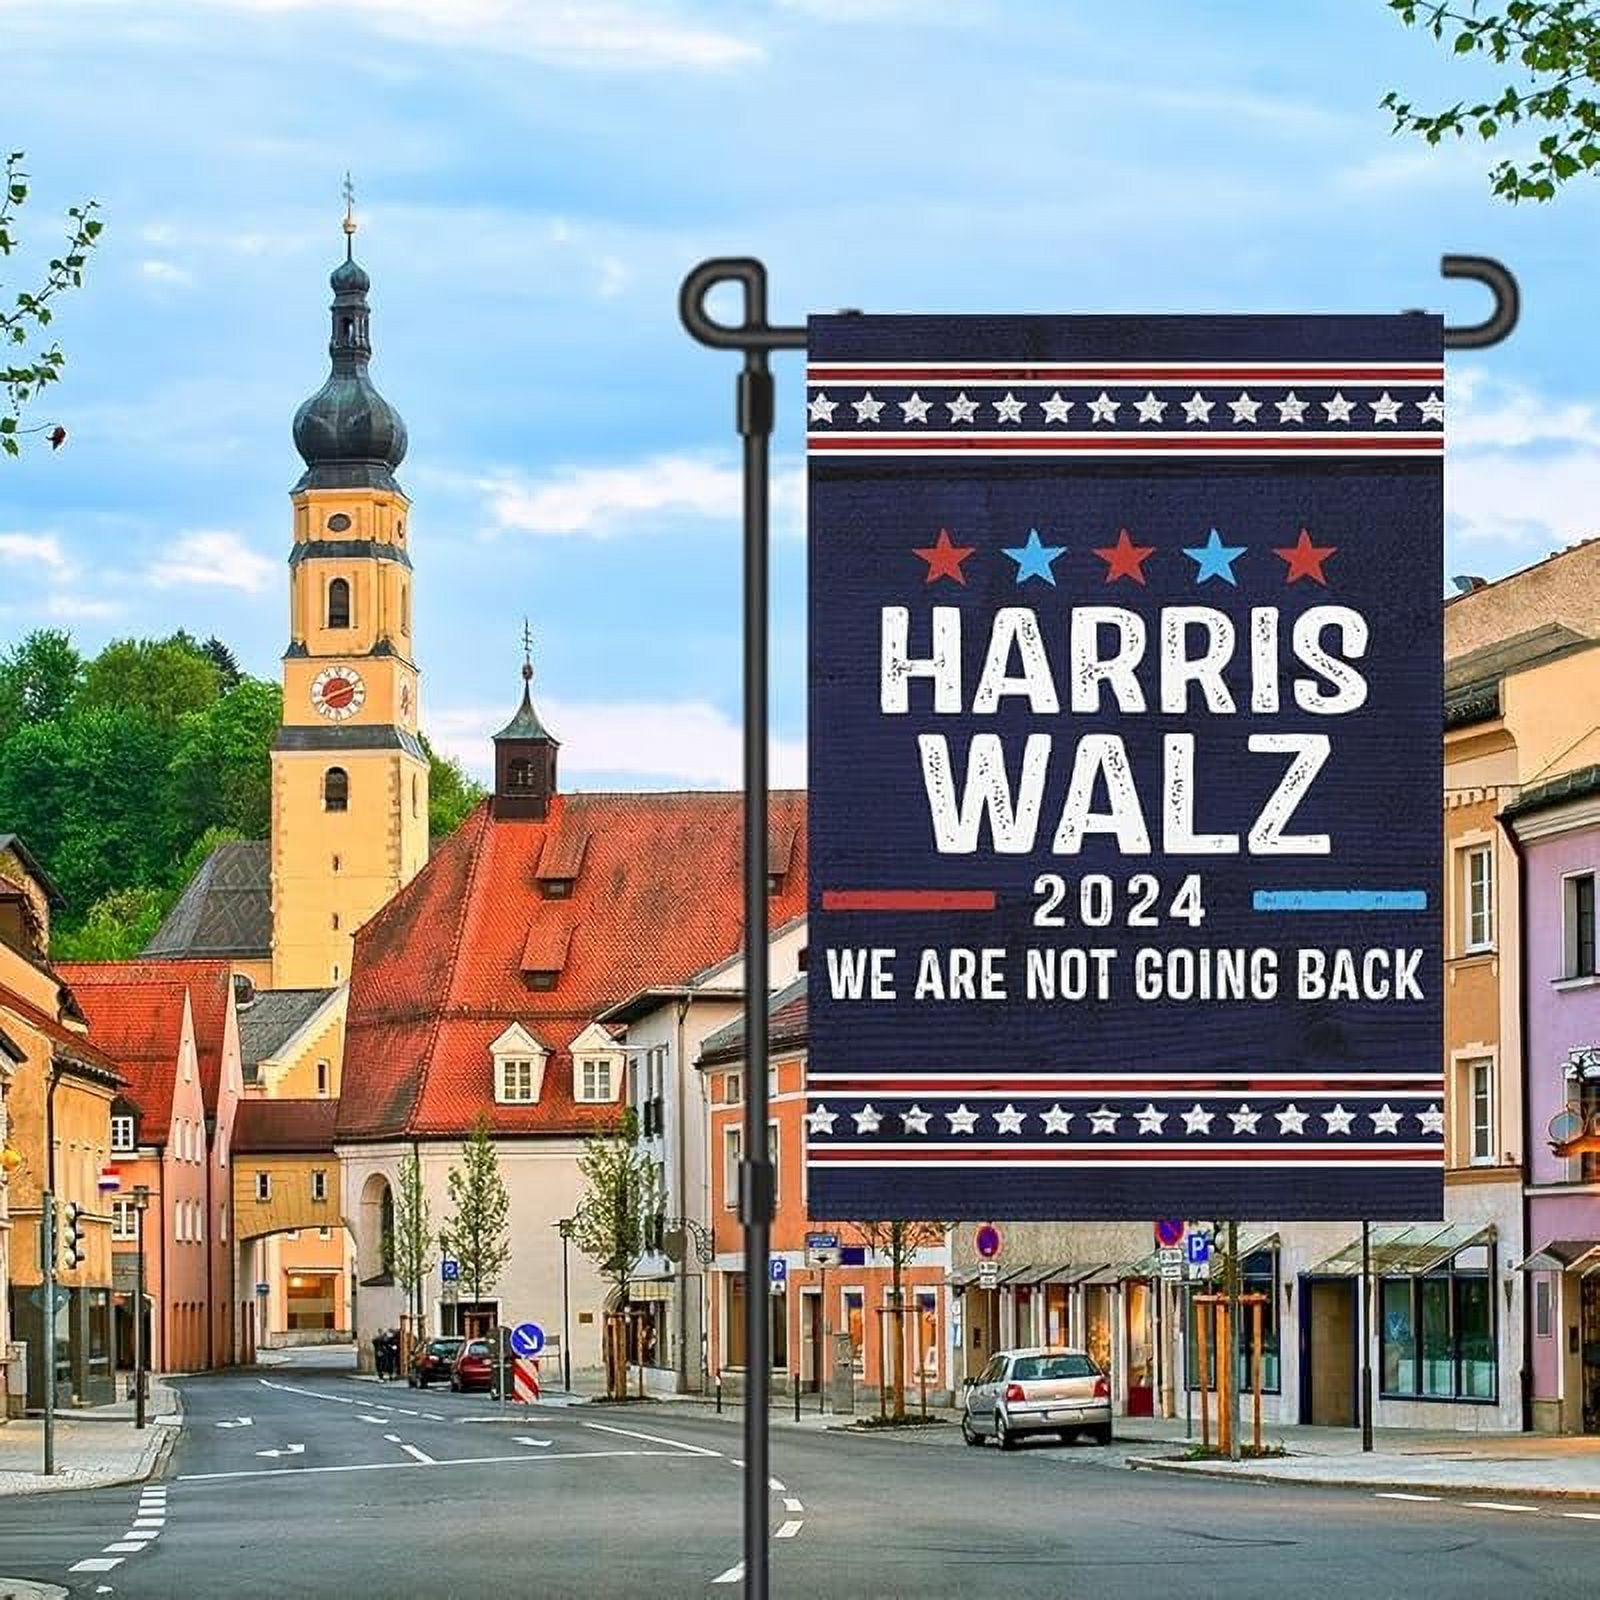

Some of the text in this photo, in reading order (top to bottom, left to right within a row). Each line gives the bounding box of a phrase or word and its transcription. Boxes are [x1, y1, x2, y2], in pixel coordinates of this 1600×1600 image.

[881, 606, 1368, 714] HARRIS
[918, 733, 1331, 854] WALZ
[1033, 874, 1206, 927] 2024
[827, 948, 1425, 1000] WE ARE NOT GOING BACK
[773, 1262, 783, 1277] P
[1192, 1237, 1204, 1259] P
